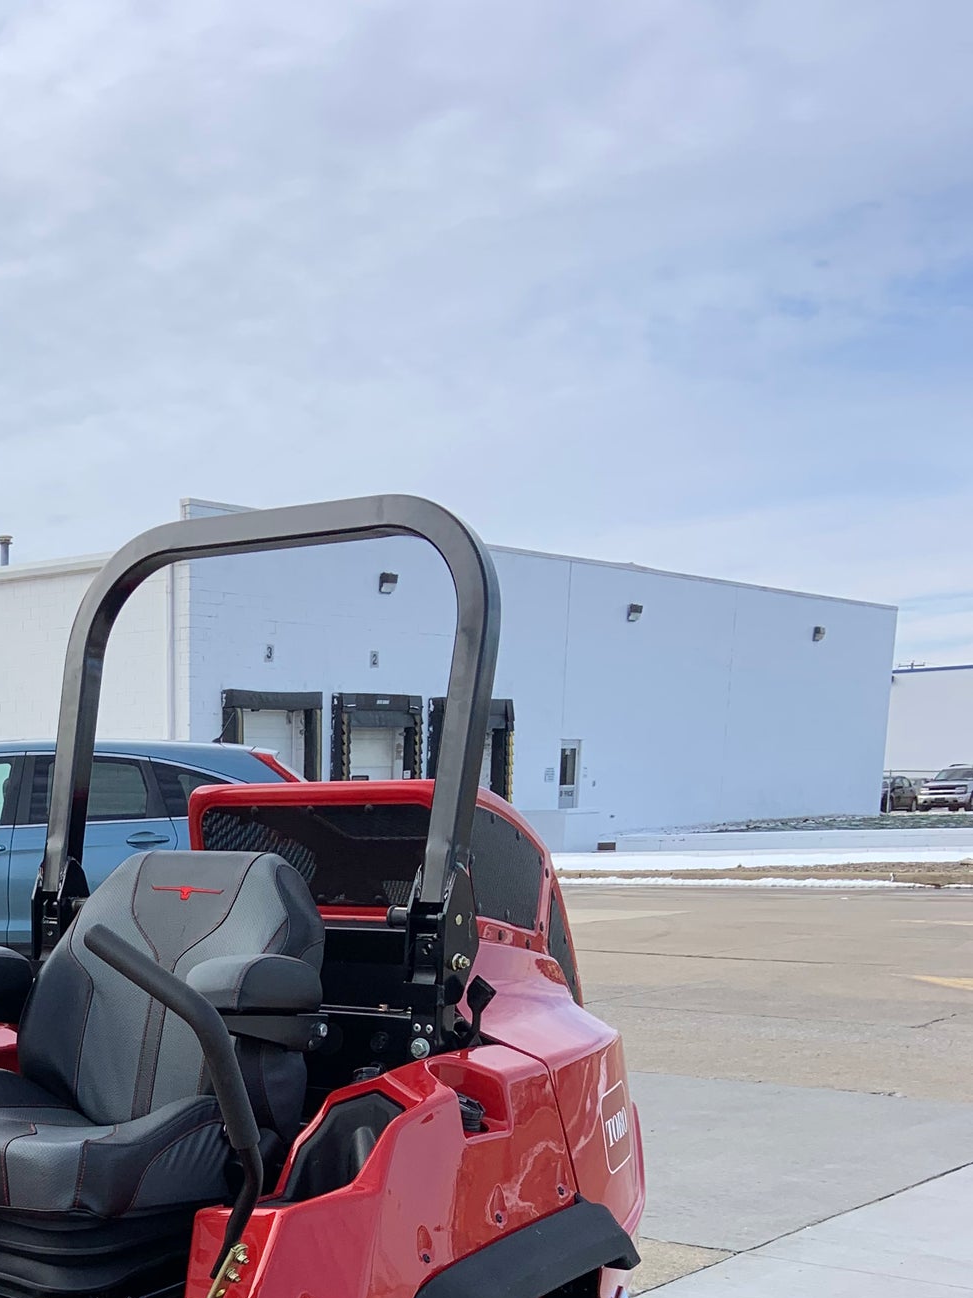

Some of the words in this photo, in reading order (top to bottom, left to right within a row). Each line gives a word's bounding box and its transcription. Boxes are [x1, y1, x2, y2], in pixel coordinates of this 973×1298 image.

[265, 646, 273, 659] 3
[371, 653, 378, 665] 2
[605, 1106, 628, 1147] TORO
